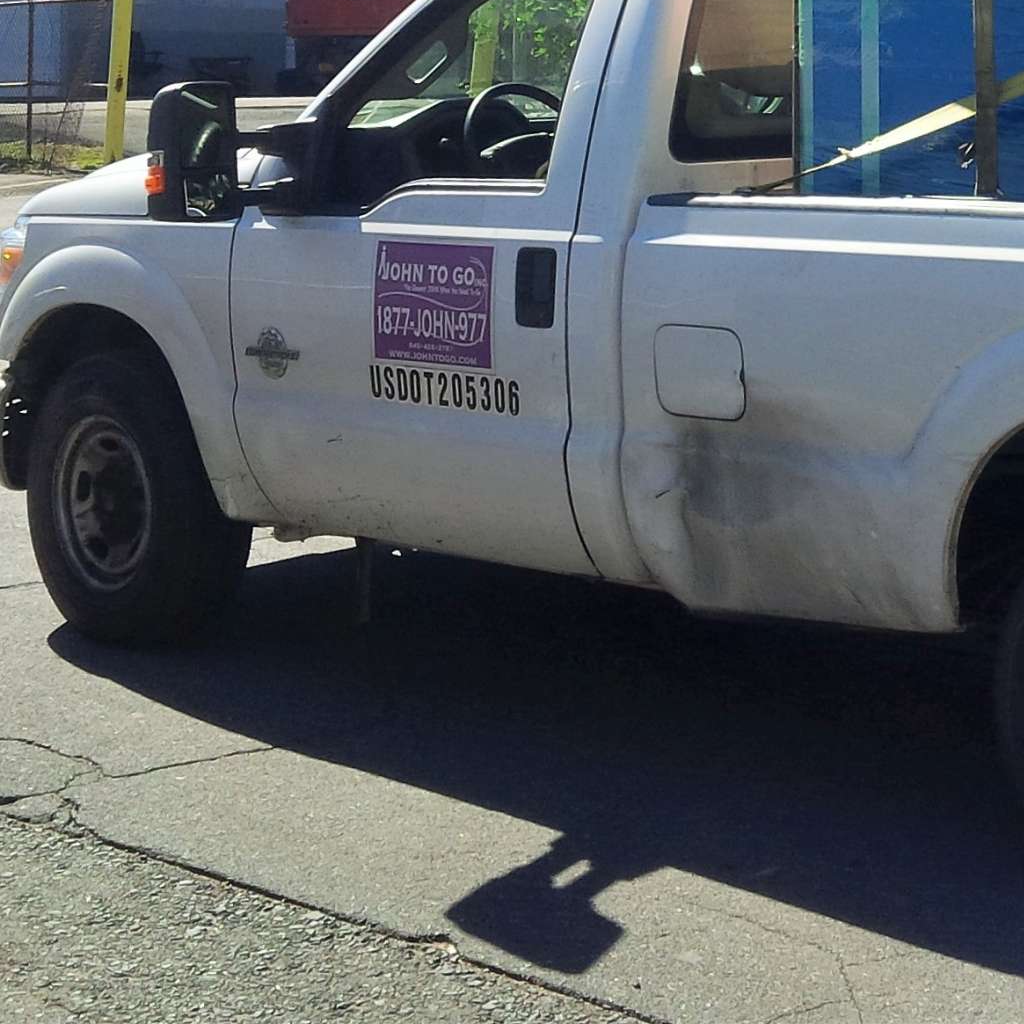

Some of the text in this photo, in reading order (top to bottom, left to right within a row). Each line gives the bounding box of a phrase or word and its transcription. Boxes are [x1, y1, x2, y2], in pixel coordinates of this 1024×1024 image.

[380, 261, 424, 283] JOHN
[428, 264, 448, 284] TO
[453, 267, 475, 286] GO
